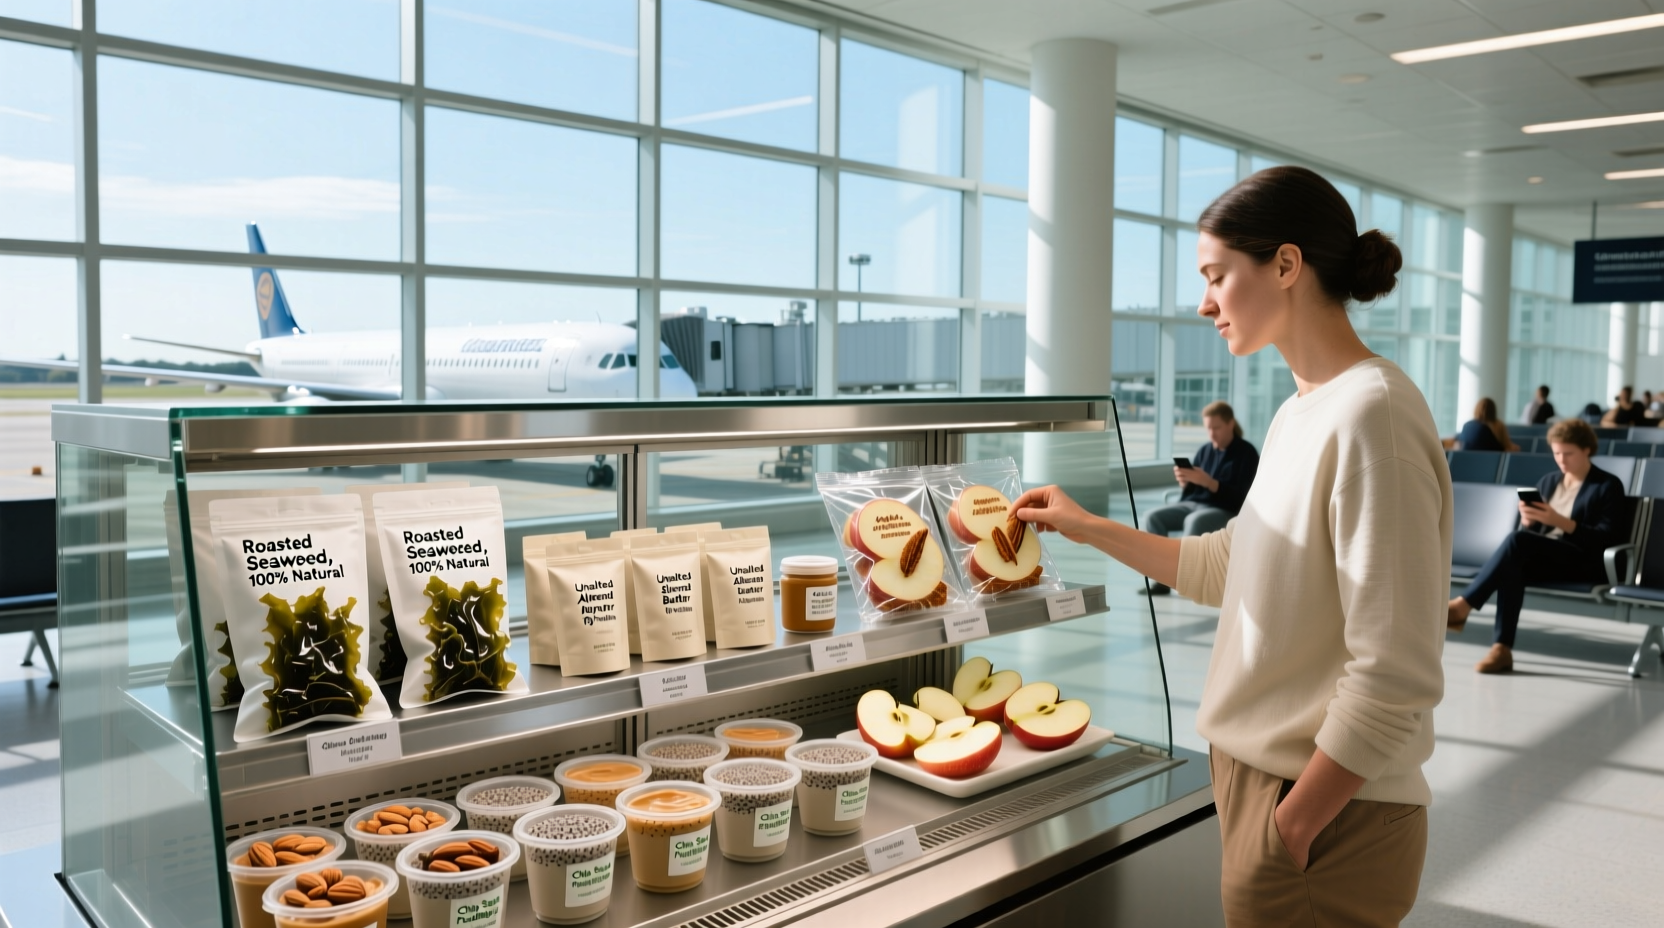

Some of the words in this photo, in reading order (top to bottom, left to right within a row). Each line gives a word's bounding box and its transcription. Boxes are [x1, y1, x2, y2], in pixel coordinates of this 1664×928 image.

[242, 533, 313, 554] Roasted
[403, 525, 464, 545] Roasted
[246, 548, 333, 571] Seaweed,
[408, 559, 444, 575] 100%
[446, 556, 490, 571] Natural
[248, 570, 289, 587] 100%
[292, 563, 345, 582] Natural
